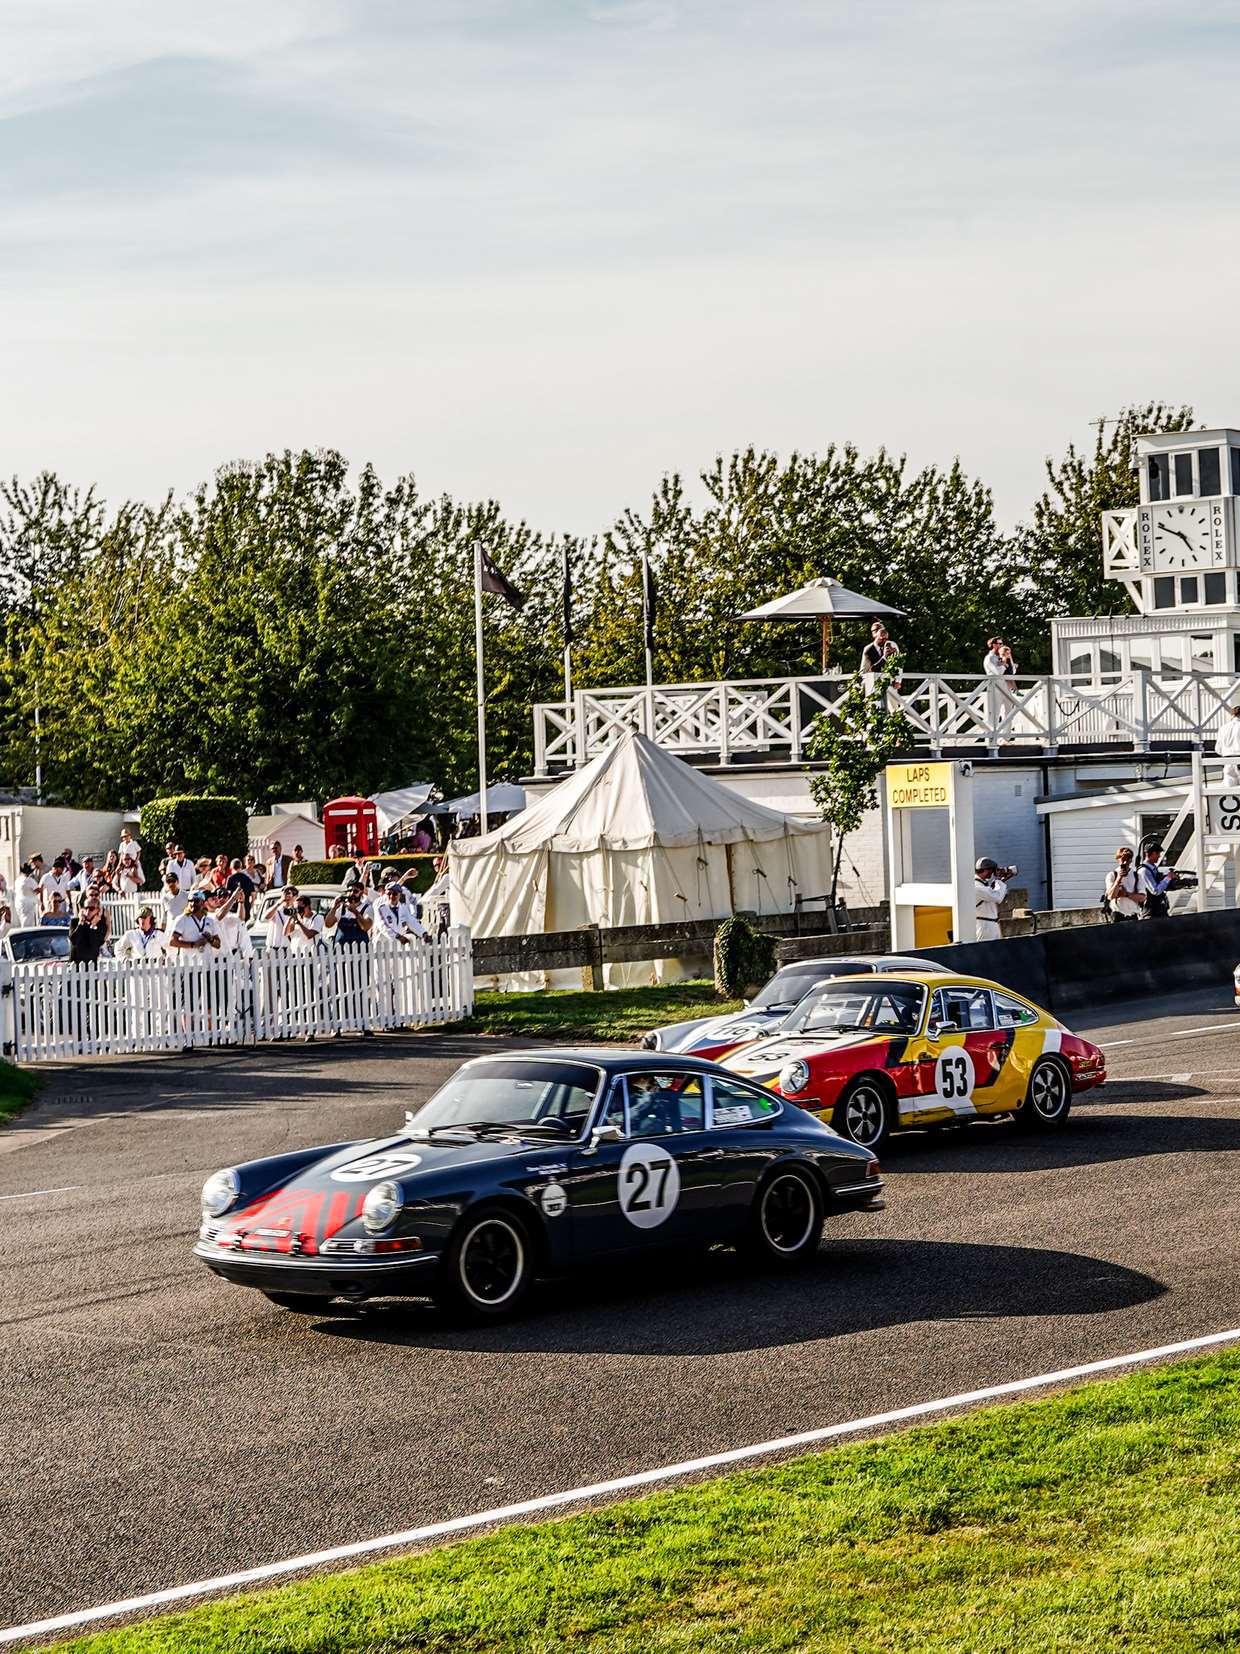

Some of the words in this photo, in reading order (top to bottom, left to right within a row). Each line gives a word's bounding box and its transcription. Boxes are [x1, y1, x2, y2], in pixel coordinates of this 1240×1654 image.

[1142, 512, 1151, 566] ROLEX
[1213, 506, 1223, 560] ROLEX
[906, 767, 930, 782] LAPS
[893, 787, 946, 803] COMPLETED
[748, 1053, 791, 1061] 53
[942, 1057, 967, 1099] 53
[340, 1159, 413, 1175] 27
[626, 1159, 671, 1213] 27
